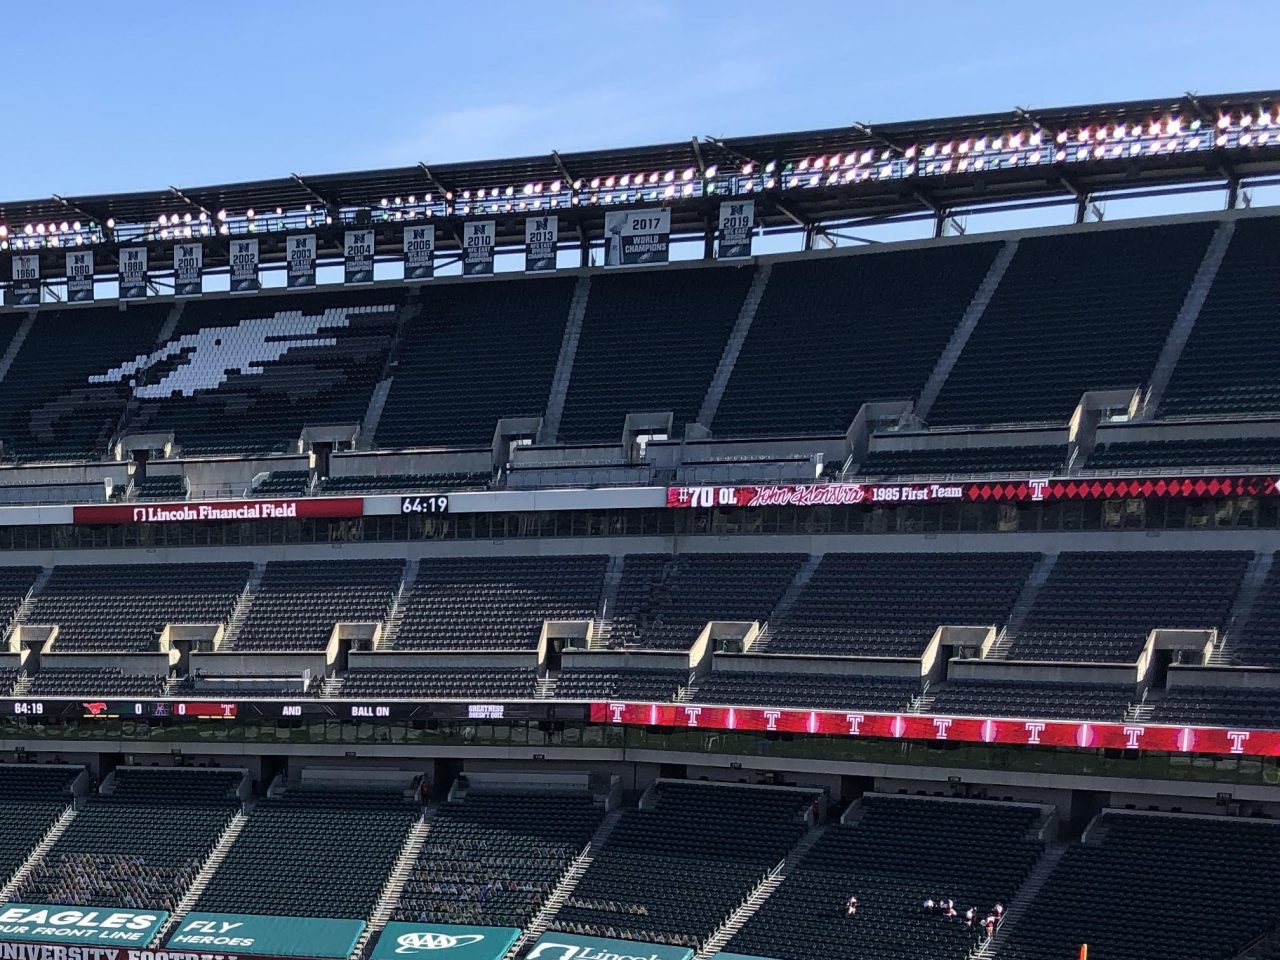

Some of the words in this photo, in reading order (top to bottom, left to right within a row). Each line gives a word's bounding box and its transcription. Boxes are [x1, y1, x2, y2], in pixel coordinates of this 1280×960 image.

[633, 218, 661, 231] 2017
[723, 216, 749, 228] 2019
[467, 236, 491, 246] 2010
[529, 231, 553, 242] 2013
[633, 235, 659, 245] WORLD
[347, 245, 371, 255] 2004
[407, 241, 430, 250] 2006
[625, 242, 667, 253] CHAMPIONS
[233, 254, 255, 264] 2002
[291, 250, 312, 259] 2003
[178, 258, 198, 268] 2001
[679, 487, 713, 507] #70
[720, 488, 737, 504] OL
[872, 487, 900, 501] 1985
[902, 487, 928, 500] First
[931, 486, 962, 498] Team
[402, 497, 448, 513] 64:19
[148, 508, 197, 521] Lincoln
[199, 505, 260, 519] Financial
[262, 503, 297, 517] Field
[14, 703, 43, 714] 64:19
[135, 703, 142, 714] 0
[178, 703, 186, 714] 0
[282, 706, 301, 716] AND
[351, 706, 374, 716] BALL
[375, 706, 390, 717] ON
[182, 920, 244, 934] FLY
[31, 926, 98, 938] FRONT
[98, 930, 144, 941] LINE
[173, 934, 255, 947] HEROES
